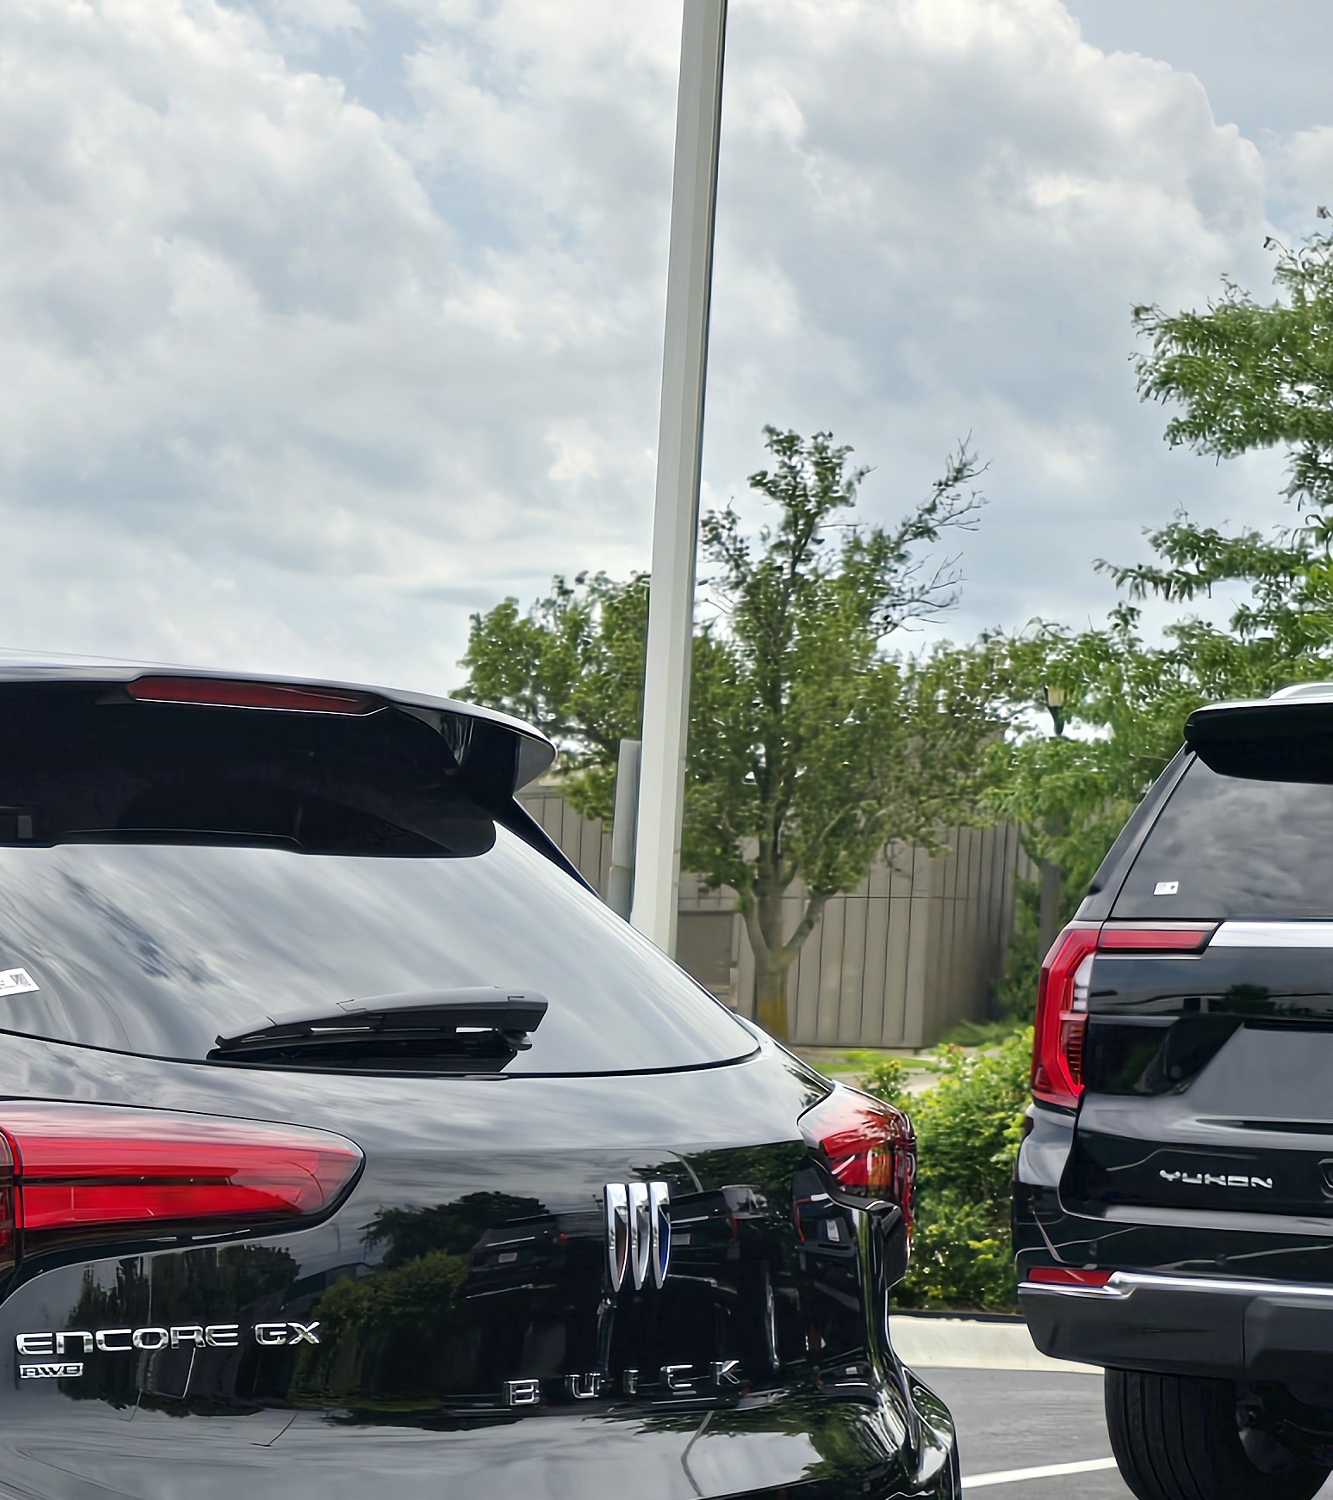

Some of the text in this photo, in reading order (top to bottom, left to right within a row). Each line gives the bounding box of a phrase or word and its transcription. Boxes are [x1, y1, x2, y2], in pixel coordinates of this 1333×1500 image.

[1159, 1169, 1273, 1189] YUKON
[16, 1321, 321, 1355] ENCORE GX
[20, 1364, 82, 1378] AWD
[504, 1360, 740, 1406] BUICK
